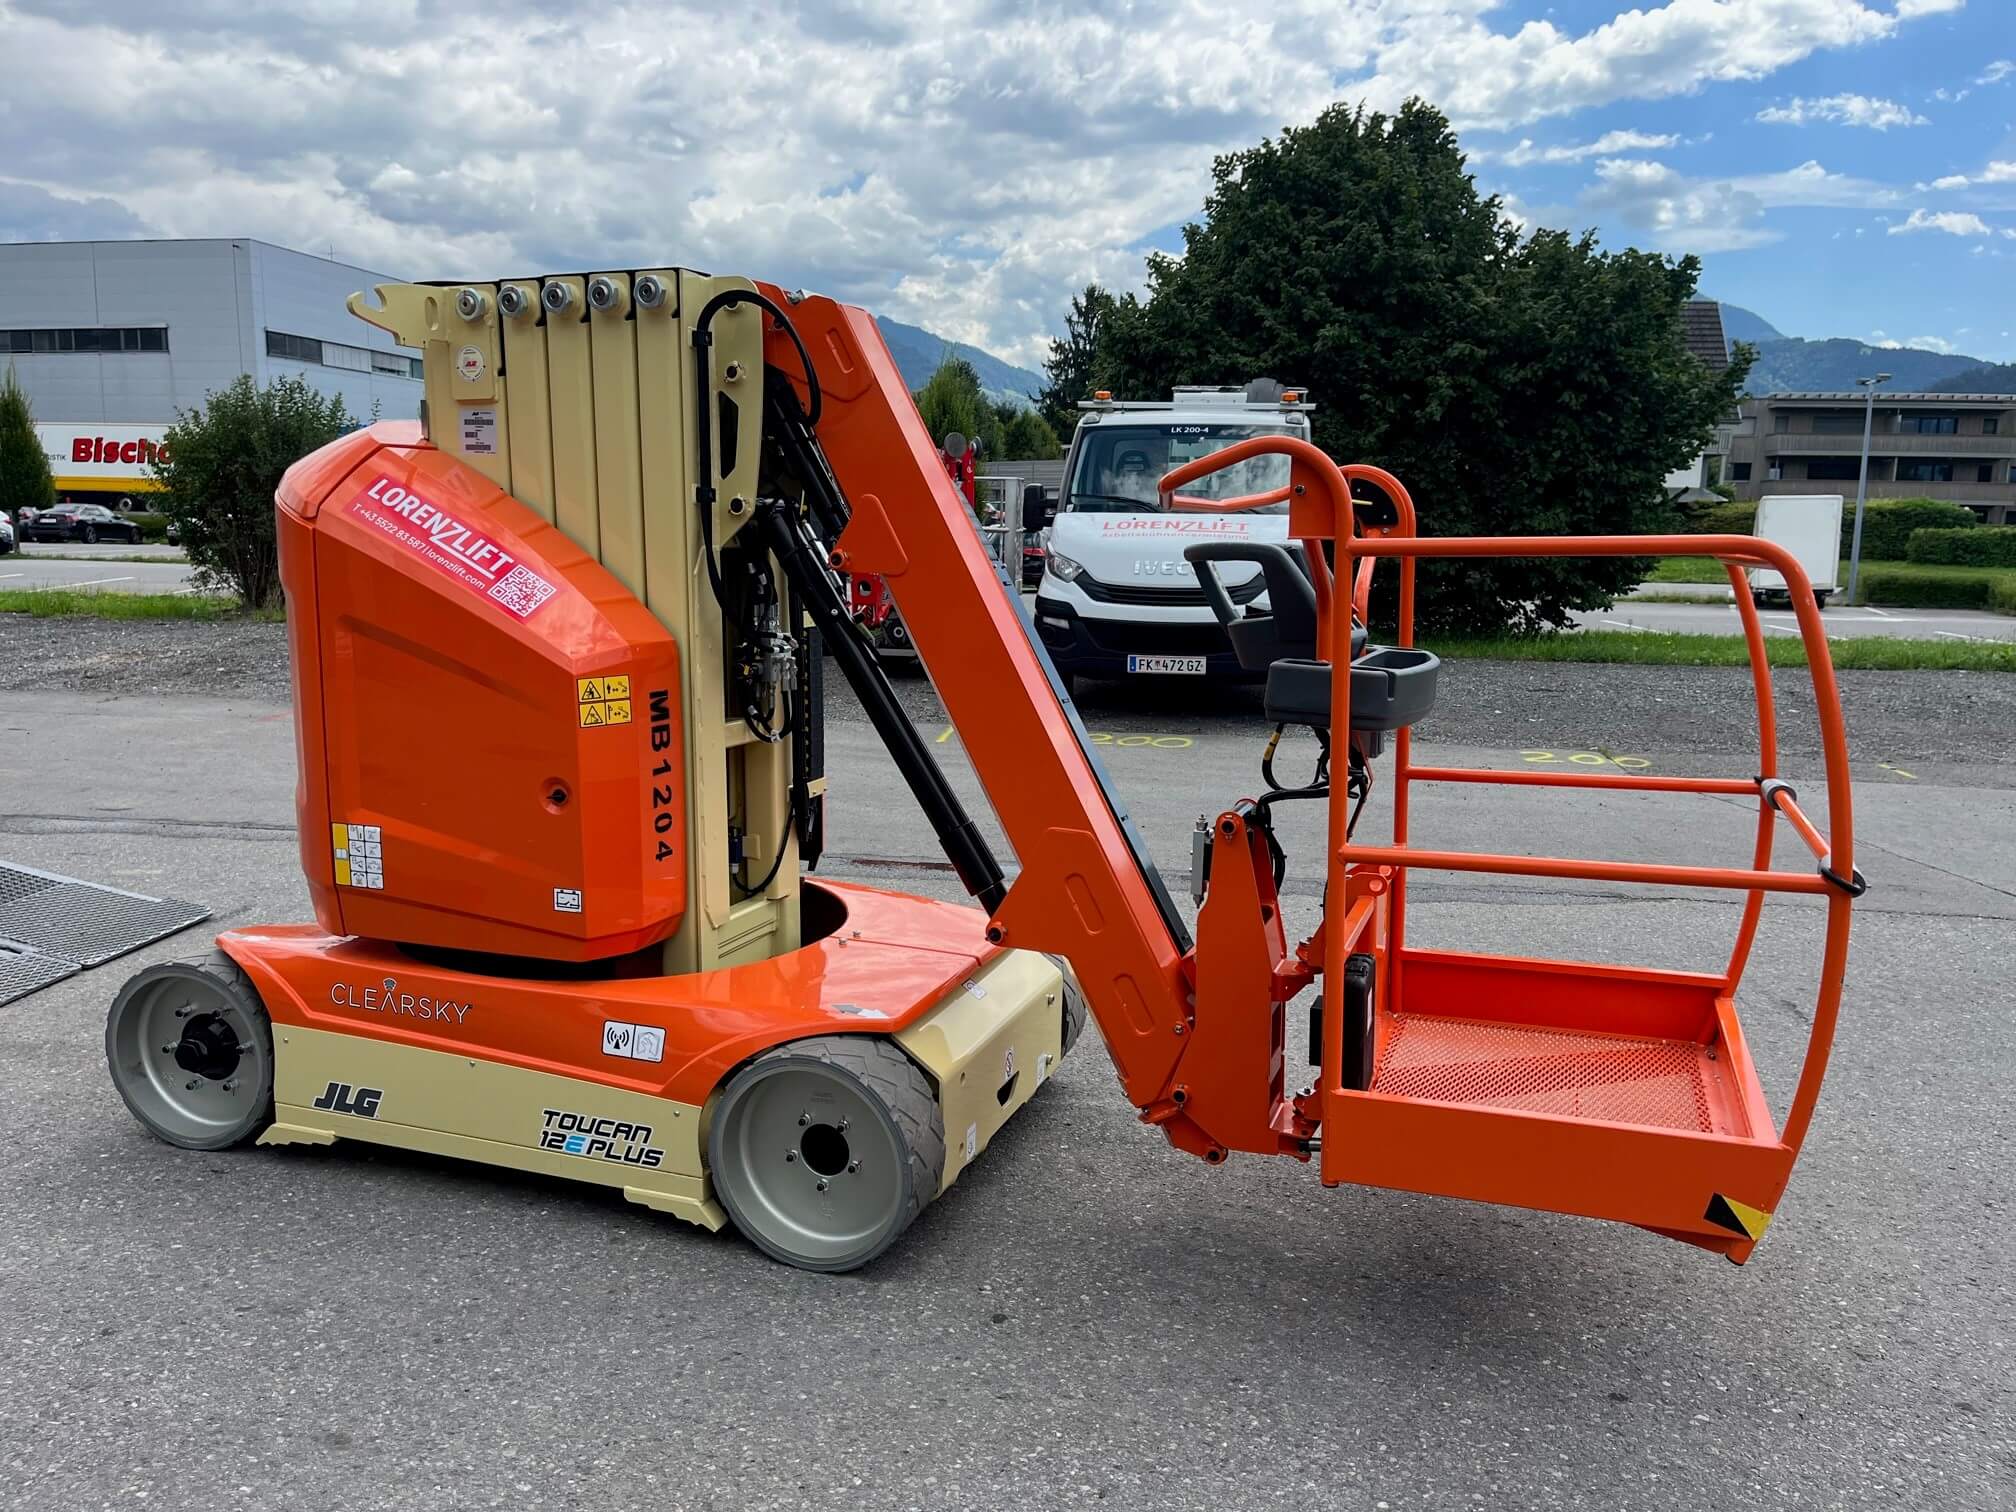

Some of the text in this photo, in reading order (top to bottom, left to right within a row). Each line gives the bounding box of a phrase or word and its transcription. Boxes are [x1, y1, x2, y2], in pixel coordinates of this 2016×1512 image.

[368, 479, 514, 580] LORENZLIFT
[1103, 521, 1249, 534] LORENZLIFT
[352, 503, 362, 512] T
[360, 508, 378, 522] +43
[375, 516, 398, 534] 5522
[395, 528, 408, 542] 83
[406, 535, 426, 552] 587
[428, 548, 486, 590] lorenzlift.com
[1133, 560, 1192, 576] IVEC
[1139, 659, 1202, 672] FK 472 GZ
[648, 689, 674, 862] MB1204
[1519, 751, 1652, 769] 200
[331, 983, 470, 1024] CLEARSKY
[314, 1082, 384, 1118] JLG
[543, 1109, 653, 1144] TOUCAN
[585, 1138, 665, 1167] PLUS
